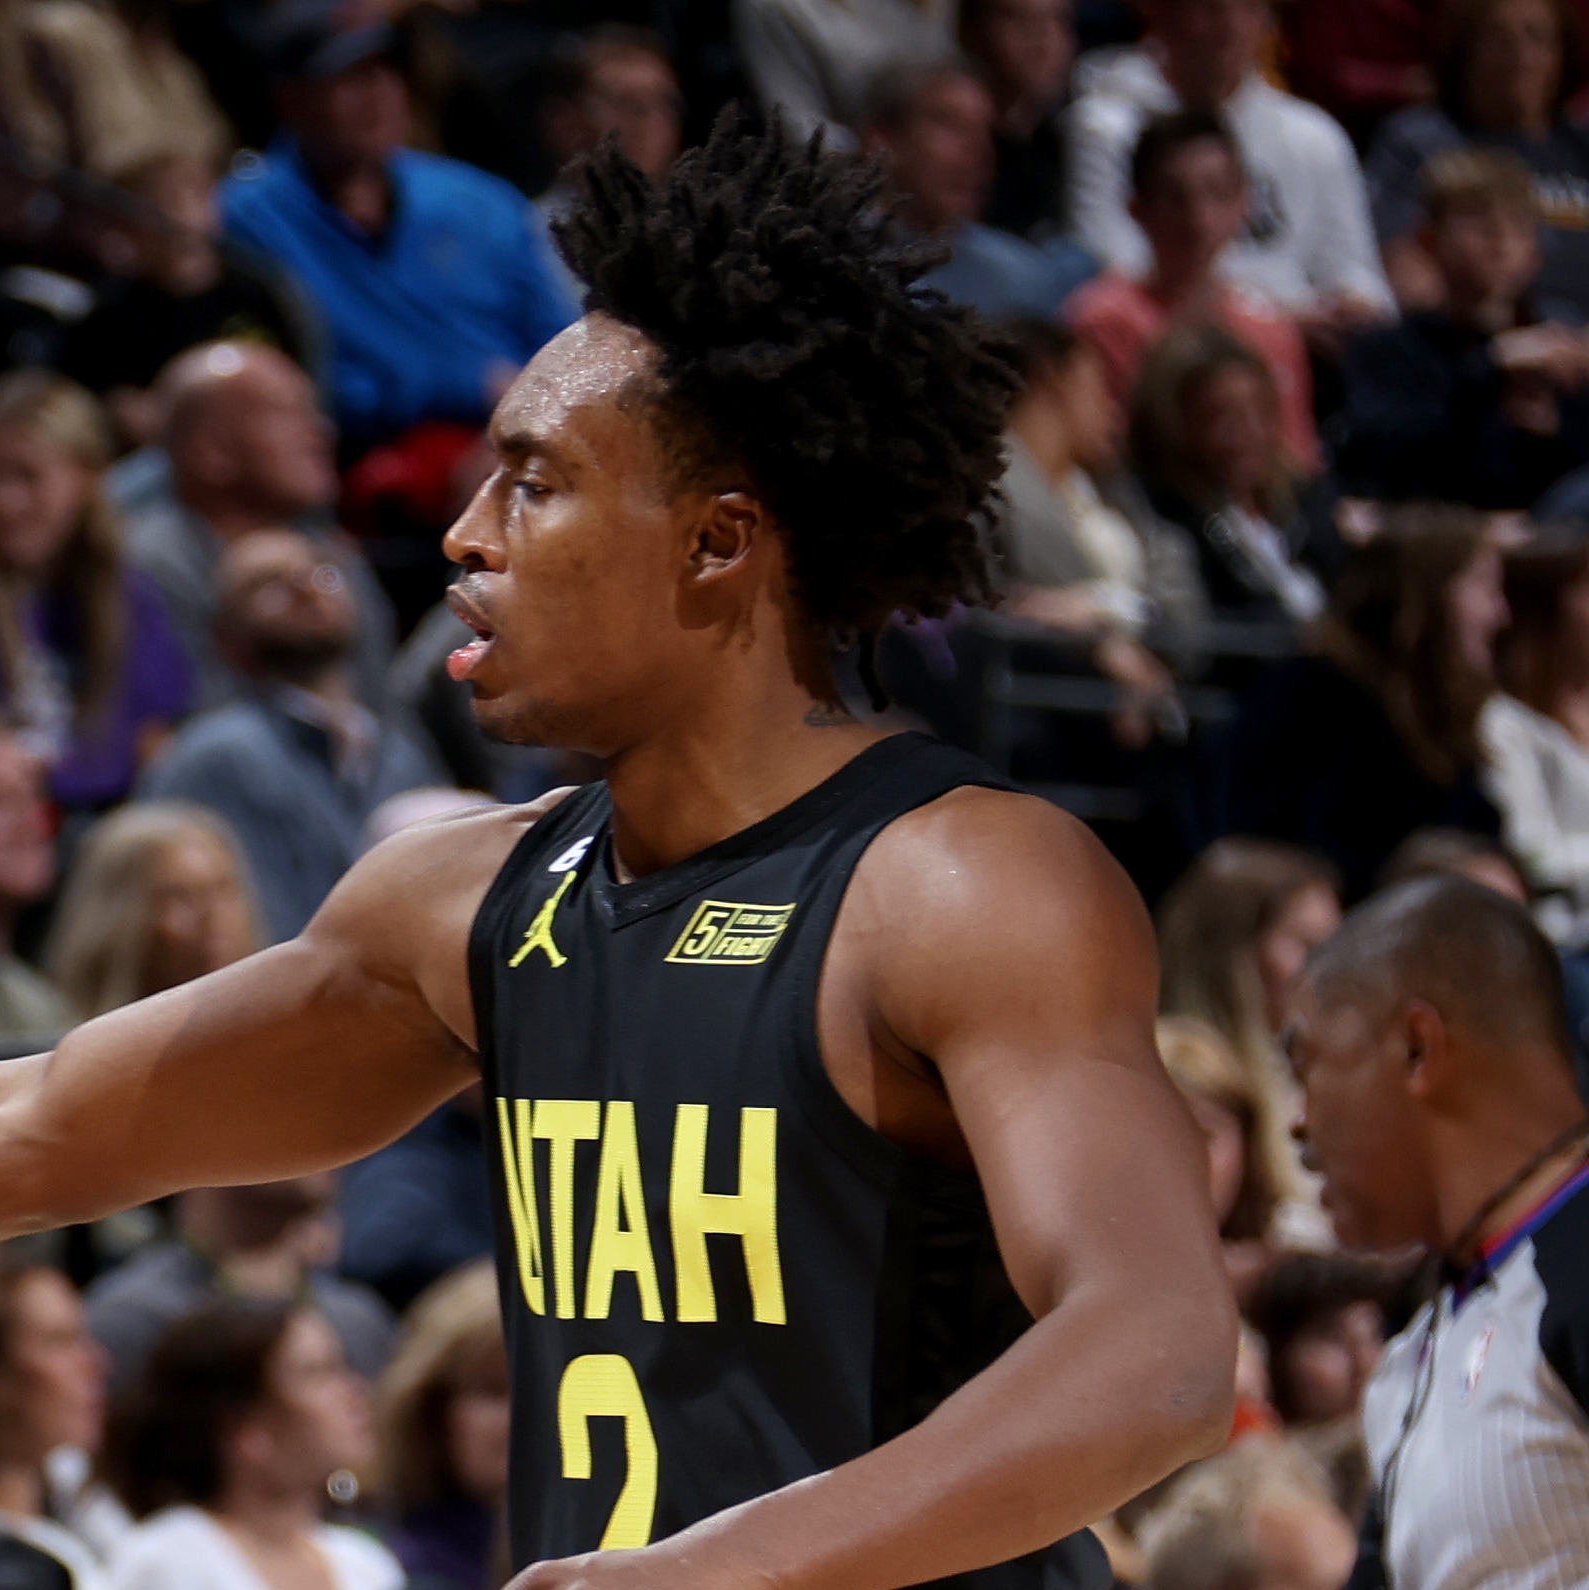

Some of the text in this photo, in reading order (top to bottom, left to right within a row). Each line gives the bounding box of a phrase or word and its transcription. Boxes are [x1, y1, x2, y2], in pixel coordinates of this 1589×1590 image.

[548, 836, 595, 873] 6
[682, 910, 731, 956] 5
[494, 1096, 788, 1326] UTAH
